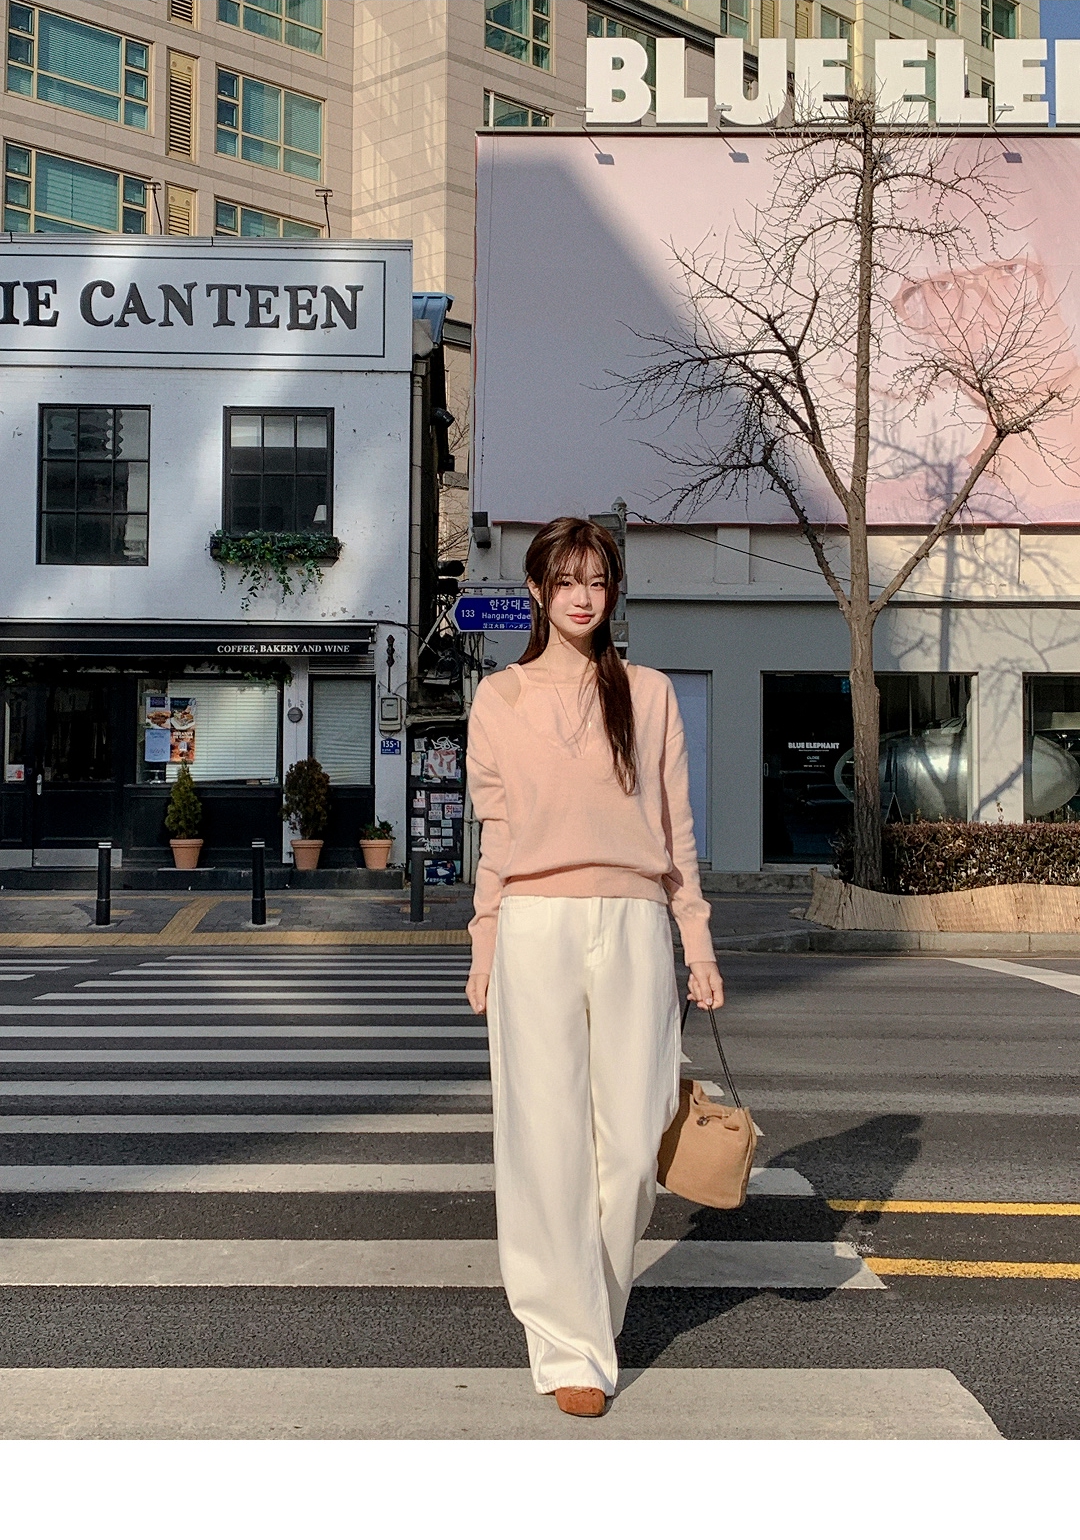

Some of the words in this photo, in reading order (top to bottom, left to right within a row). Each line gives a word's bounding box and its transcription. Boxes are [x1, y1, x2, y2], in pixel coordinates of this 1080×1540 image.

[586, 38, 848, 124] BLUE
[79, 280, 364, 330] CANTEEN
[490, 599, 530, 610] 한강대로
[462, 610, 474, 618] 133
[217, 645, 258, 654] COFFEE,
